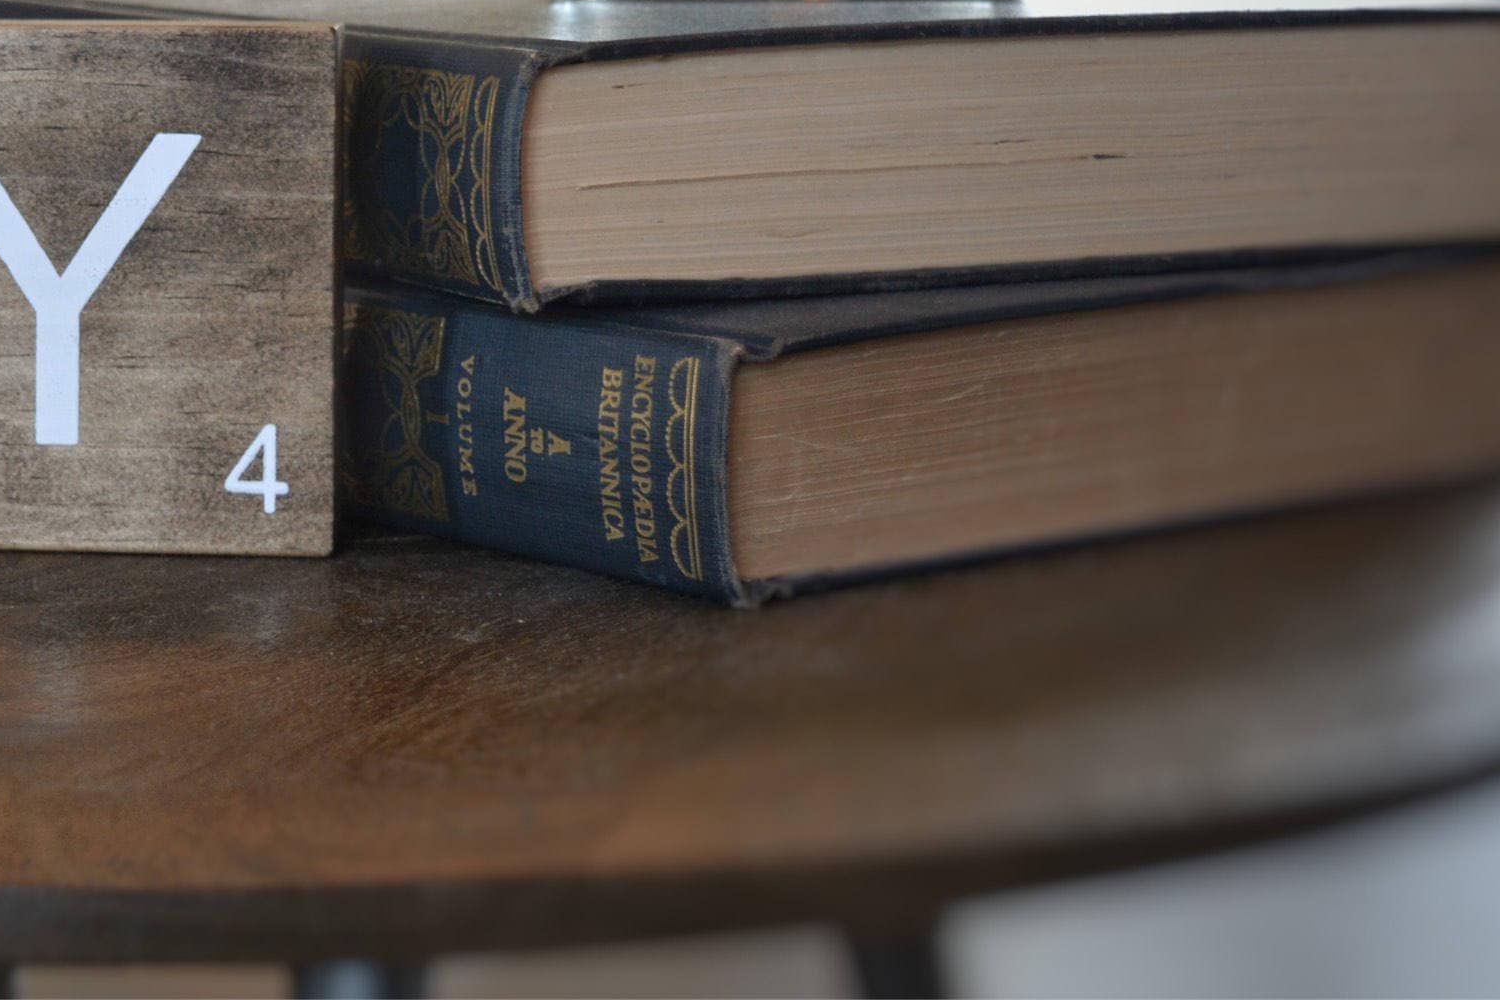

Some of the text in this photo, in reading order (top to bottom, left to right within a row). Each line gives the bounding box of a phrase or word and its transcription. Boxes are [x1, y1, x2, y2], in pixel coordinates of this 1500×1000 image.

[222, 423, 291, 514] 4
[457, 355, 478, 496] VOLUME
[503, 386, 527, 483] ANNO
[547, 431, 572, 456] A
[598, 367, 624, 541] BRITANNICA
